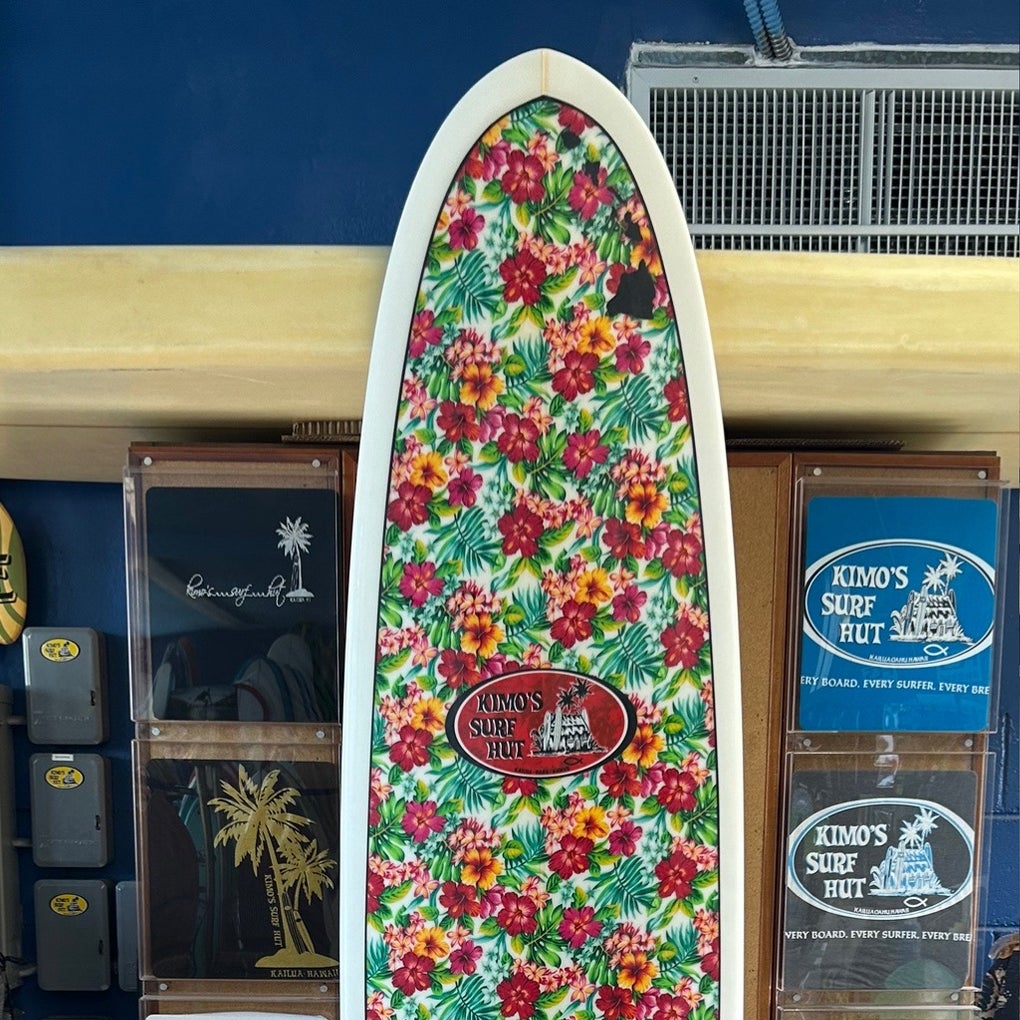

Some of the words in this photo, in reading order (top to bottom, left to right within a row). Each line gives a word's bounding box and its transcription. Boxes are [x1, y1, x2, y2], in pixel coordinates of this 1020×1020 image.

[832, 565, 908, 588] KIMO'S
[821, 592, 876, 618] SURF
[839, 622, 885, 644] HUT
[821, 677, 860, 688] BOARD.
[863, 679, 894, 689] EVERY
[897, 680, 936, 691] SURFER.
[939, 683, 969, 693] EVERY
[476, 691, 543, 713] KIMO'S
[469, 718, 516, 739] SURF
[486, 740, 525, 760] HUT
[815, 824, 888, 847] KIMO'S
[806, 853, 858, 875] SURF
[265, 874, 276, 904] KIMO'S
[824, 877, 867, 899] HUT
[270, 906, 278, 927] SURF
[274, 930, 282, 947] HUT
[812, 930, 848, 939] BOARD.
[851, 931, 880, 939] EVERY
[882, 931, 919, 939] SURFER.
[922, 932, 950, 940] EVERY
[270, 970, 304, 978] KAILUA
